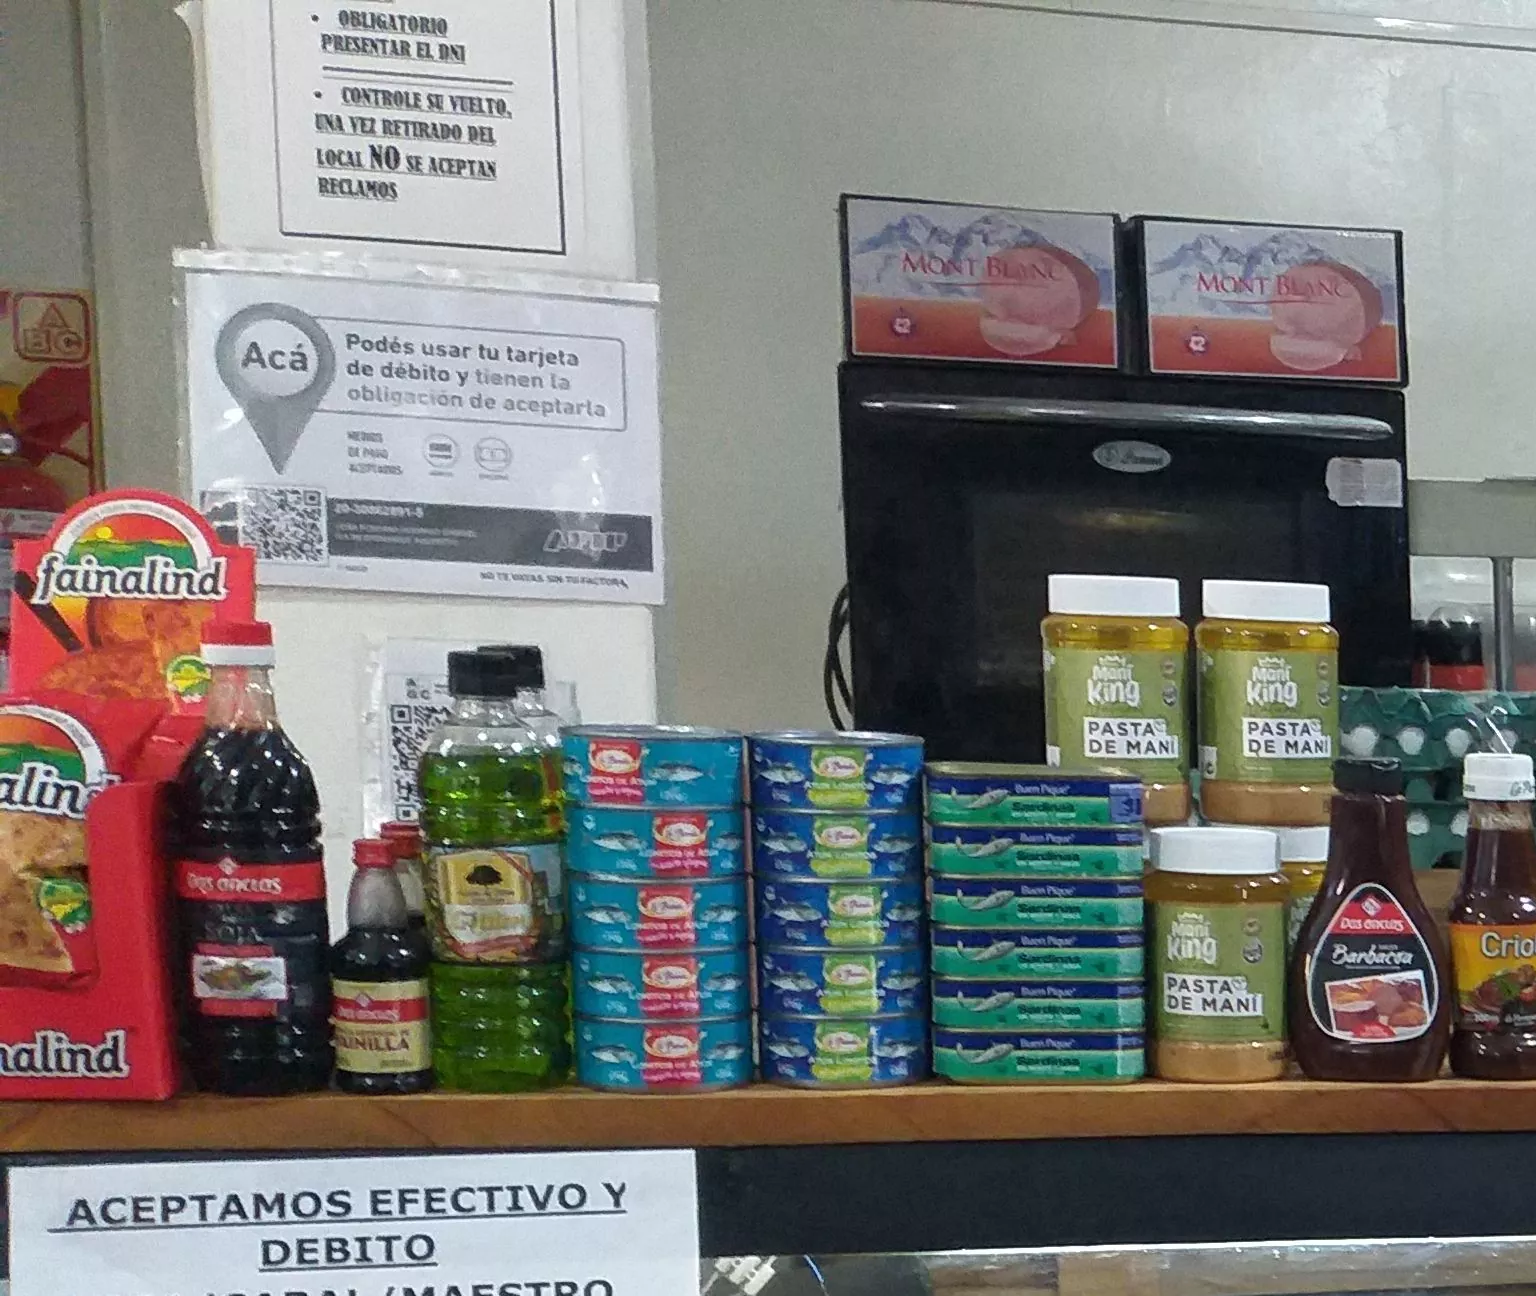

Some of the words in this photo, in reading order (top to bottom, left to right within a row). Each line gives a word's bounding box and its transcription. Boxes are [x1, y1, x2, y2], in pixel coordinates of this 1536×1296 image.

[338, 9, 448, 36] OBLIGATORIO
[321, 33, 411, 58] PRESENTAR
[416, 41, 435, 60] EL
[438, 43, 466, 63] DNI
[341, 87, 421, 109] CONTROLE
[427, 92, 444, 110] SU
[315, 113, 344, 131] UNA
[348, 116, 376, 135] VEZ
[382, 118, 462, 142] RETIRADO
[467, 125, 497, 145] DEL
[316, 148, 363, 168] LOCAL
[369, 144, 400, 170] NO
[406, 154, 423, 172] SE
[429, 156, 496, 179] ACEPTAN
[318, 176, 398, 199] RECLAMOS
[902, 252, 977, 276] MONT
[985, 257, 1062, 282] BLANC
[1196, 271, 1268, 297] MONT
[1277, 274, 1349, 300] BLANC
[241, 342, 309, 373] Acá
[345, 333, 414, 356] Podés
[422, 343, 471, 361] usar
[478, 345, 499, 363] tu
[505, 347, 580, 371] tarjeta
[347, 361, 374, 379] de
[380, 362, 451, 383] débito
[455, 368, 469, 387] y
[474, 368, 543, 389] tienen
[550, 372, 571, 391] la
[347, 385, 464, 409] obligación
[470, 392, 497, 410] de
[503, 396, 607, 419] aceptarla
[30, 552, 228, 605] fainalind
[1088, 721, 1155, 737] PASTA
[1248, 721, 1311, 737] PASTA
[1089, 739, 1116, 754] DE
[1249, 739, 1275, 754] DE
[1331, 942, 1414, 966] Barbacoa
[1167, 977, 1233, 995] PASTA
[1168, 993, 1193, 1012] DE
[66, 1190, 353, 1226] ACEPTAMOS
[369, 1183, 588, 1217] EFECTIVO
[600, 1182, 627, 1210] Y
[260, 1234, 436, 1268] DEBITO
